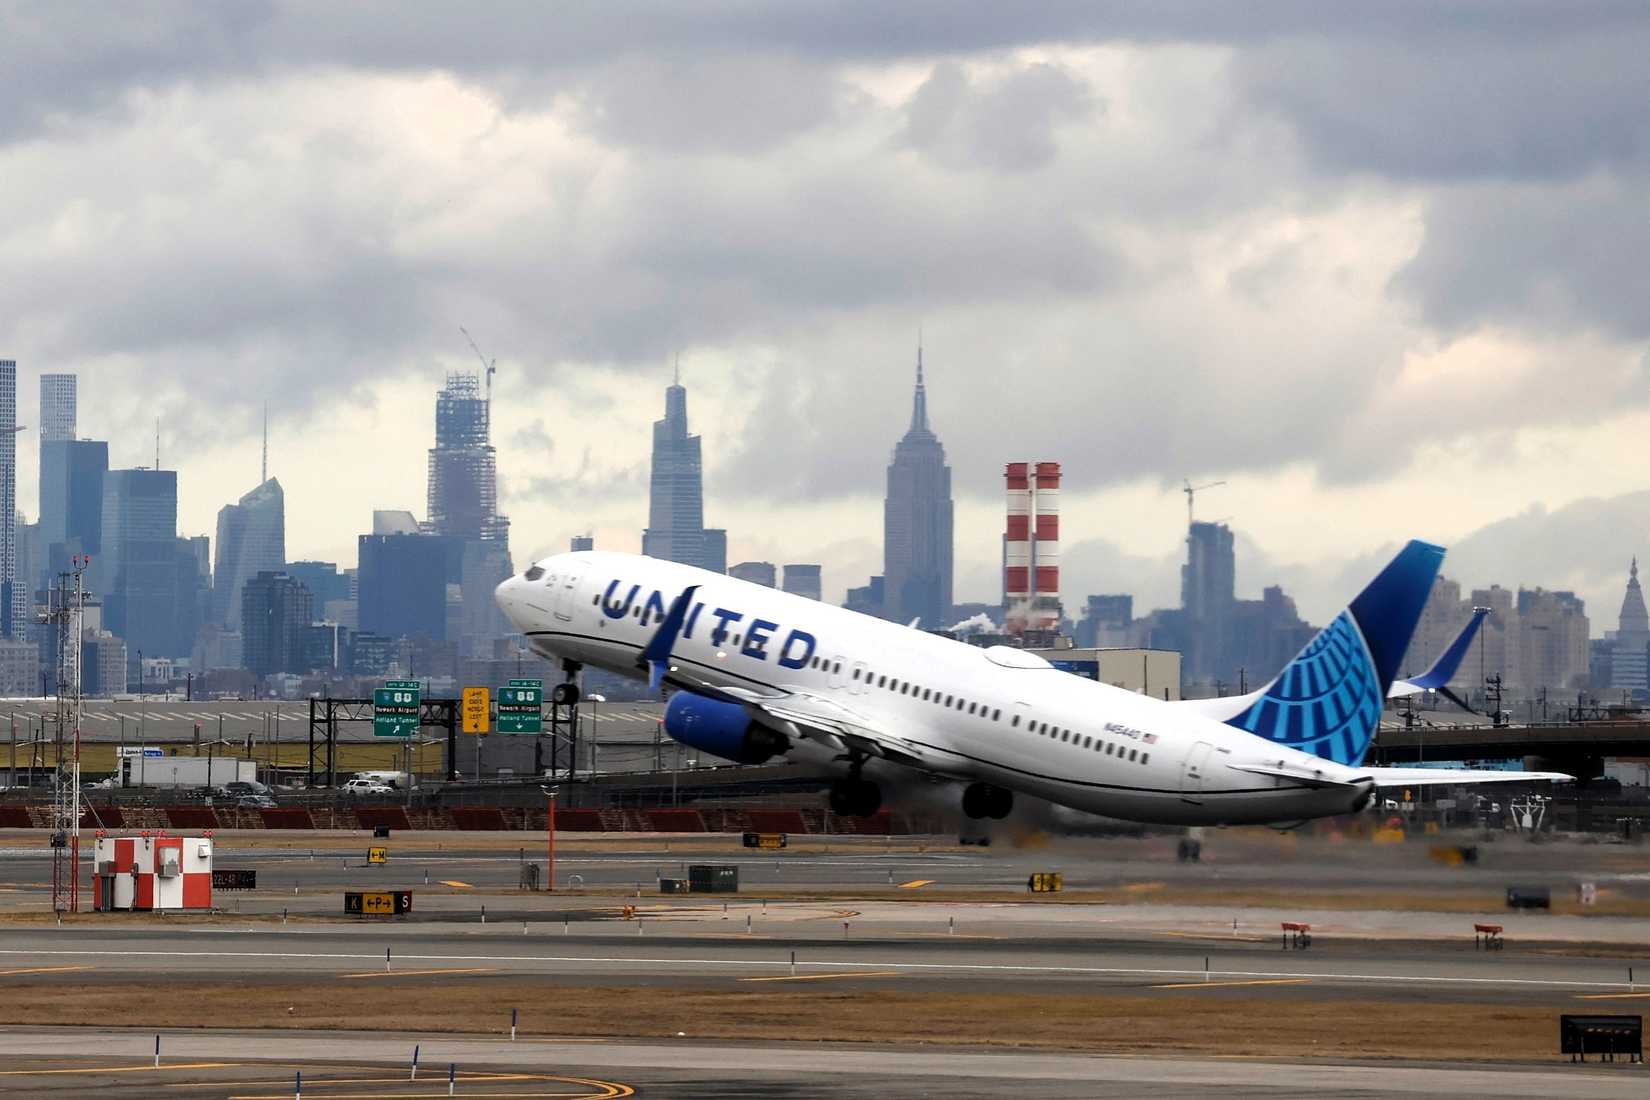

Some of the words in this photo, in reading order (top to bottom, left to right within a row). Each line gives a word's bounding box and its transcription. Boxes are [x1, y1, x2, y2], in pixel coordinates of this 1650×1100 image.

[602, 579, 816, 669] UNITED
[351, 896, 358, 909] K
[375, 896, 382, 909] P
[402, 895, 409, 908] S
